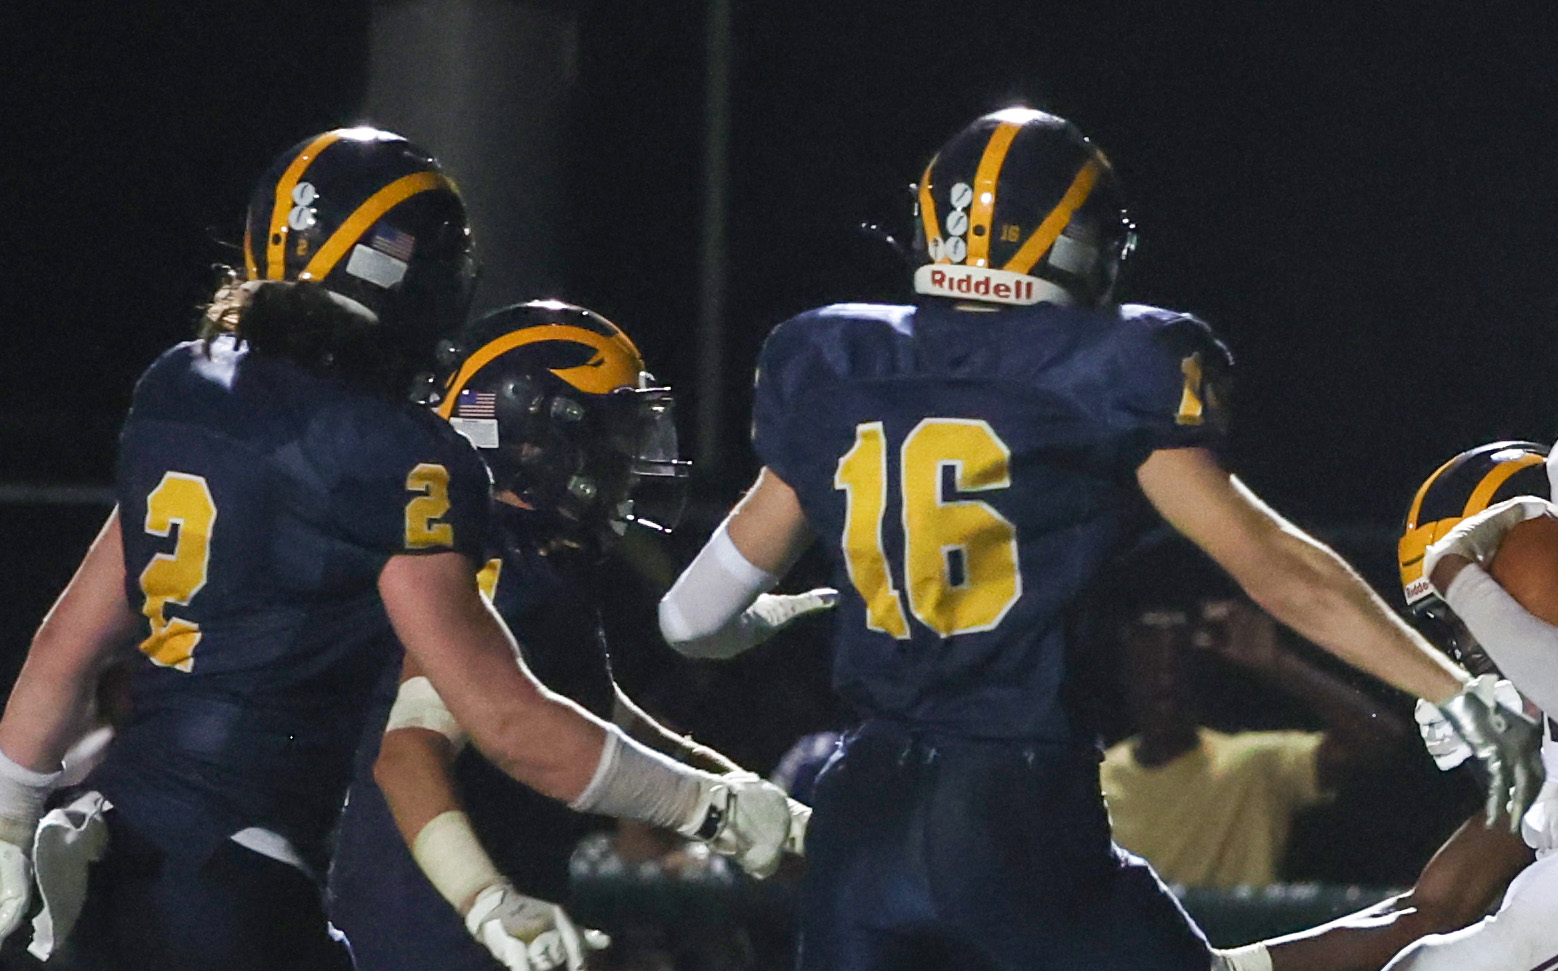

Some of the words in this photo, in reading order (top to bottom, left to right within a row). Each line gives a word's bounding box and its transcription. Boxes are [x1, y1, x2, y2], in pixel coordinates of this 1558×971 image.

[931, 270, 1034, 299] Riddell
[404, 462, 454, 549] 2
[834, 417, 1023, 640] 16
[138, 470, 218, 673] 2
[1405, 581, 1430, 599] Ridde
